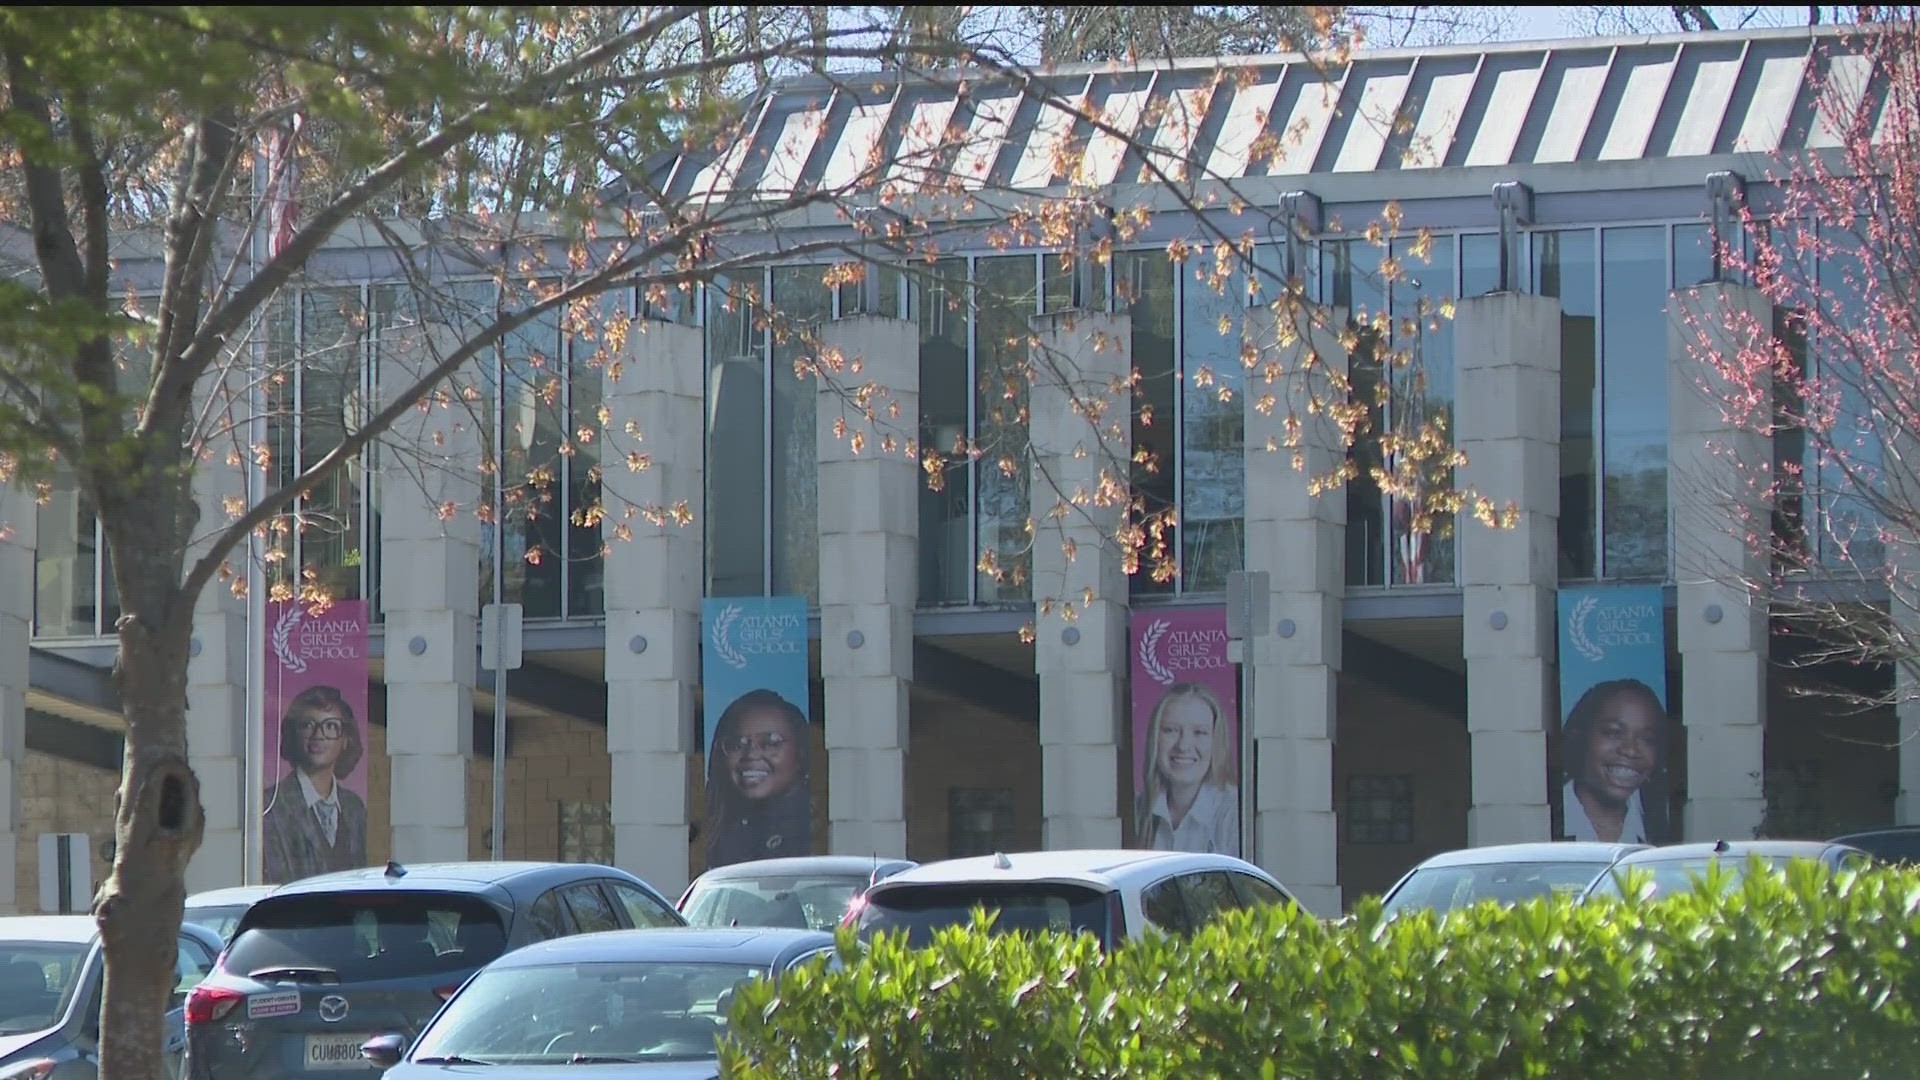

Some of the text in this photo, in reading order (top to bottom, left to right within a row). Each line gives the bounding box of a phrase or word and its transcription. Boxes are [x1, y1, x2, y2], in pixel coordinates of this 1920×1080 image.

[1598, 605, 1656, 619] ATLANTA
[301, 620, 360, 633] ATLANTA
[740, 615, 800, 628] ATLANTA
[301, 633, 345, 646] GIRLS'
[1168, 630, 1227, 643] ATLANTA
[301, 646, 359, 659] SCHOOL
[740, 640, 800, 653] SCHOOL
[1168, 655, 1226, 670] SCHOOL
